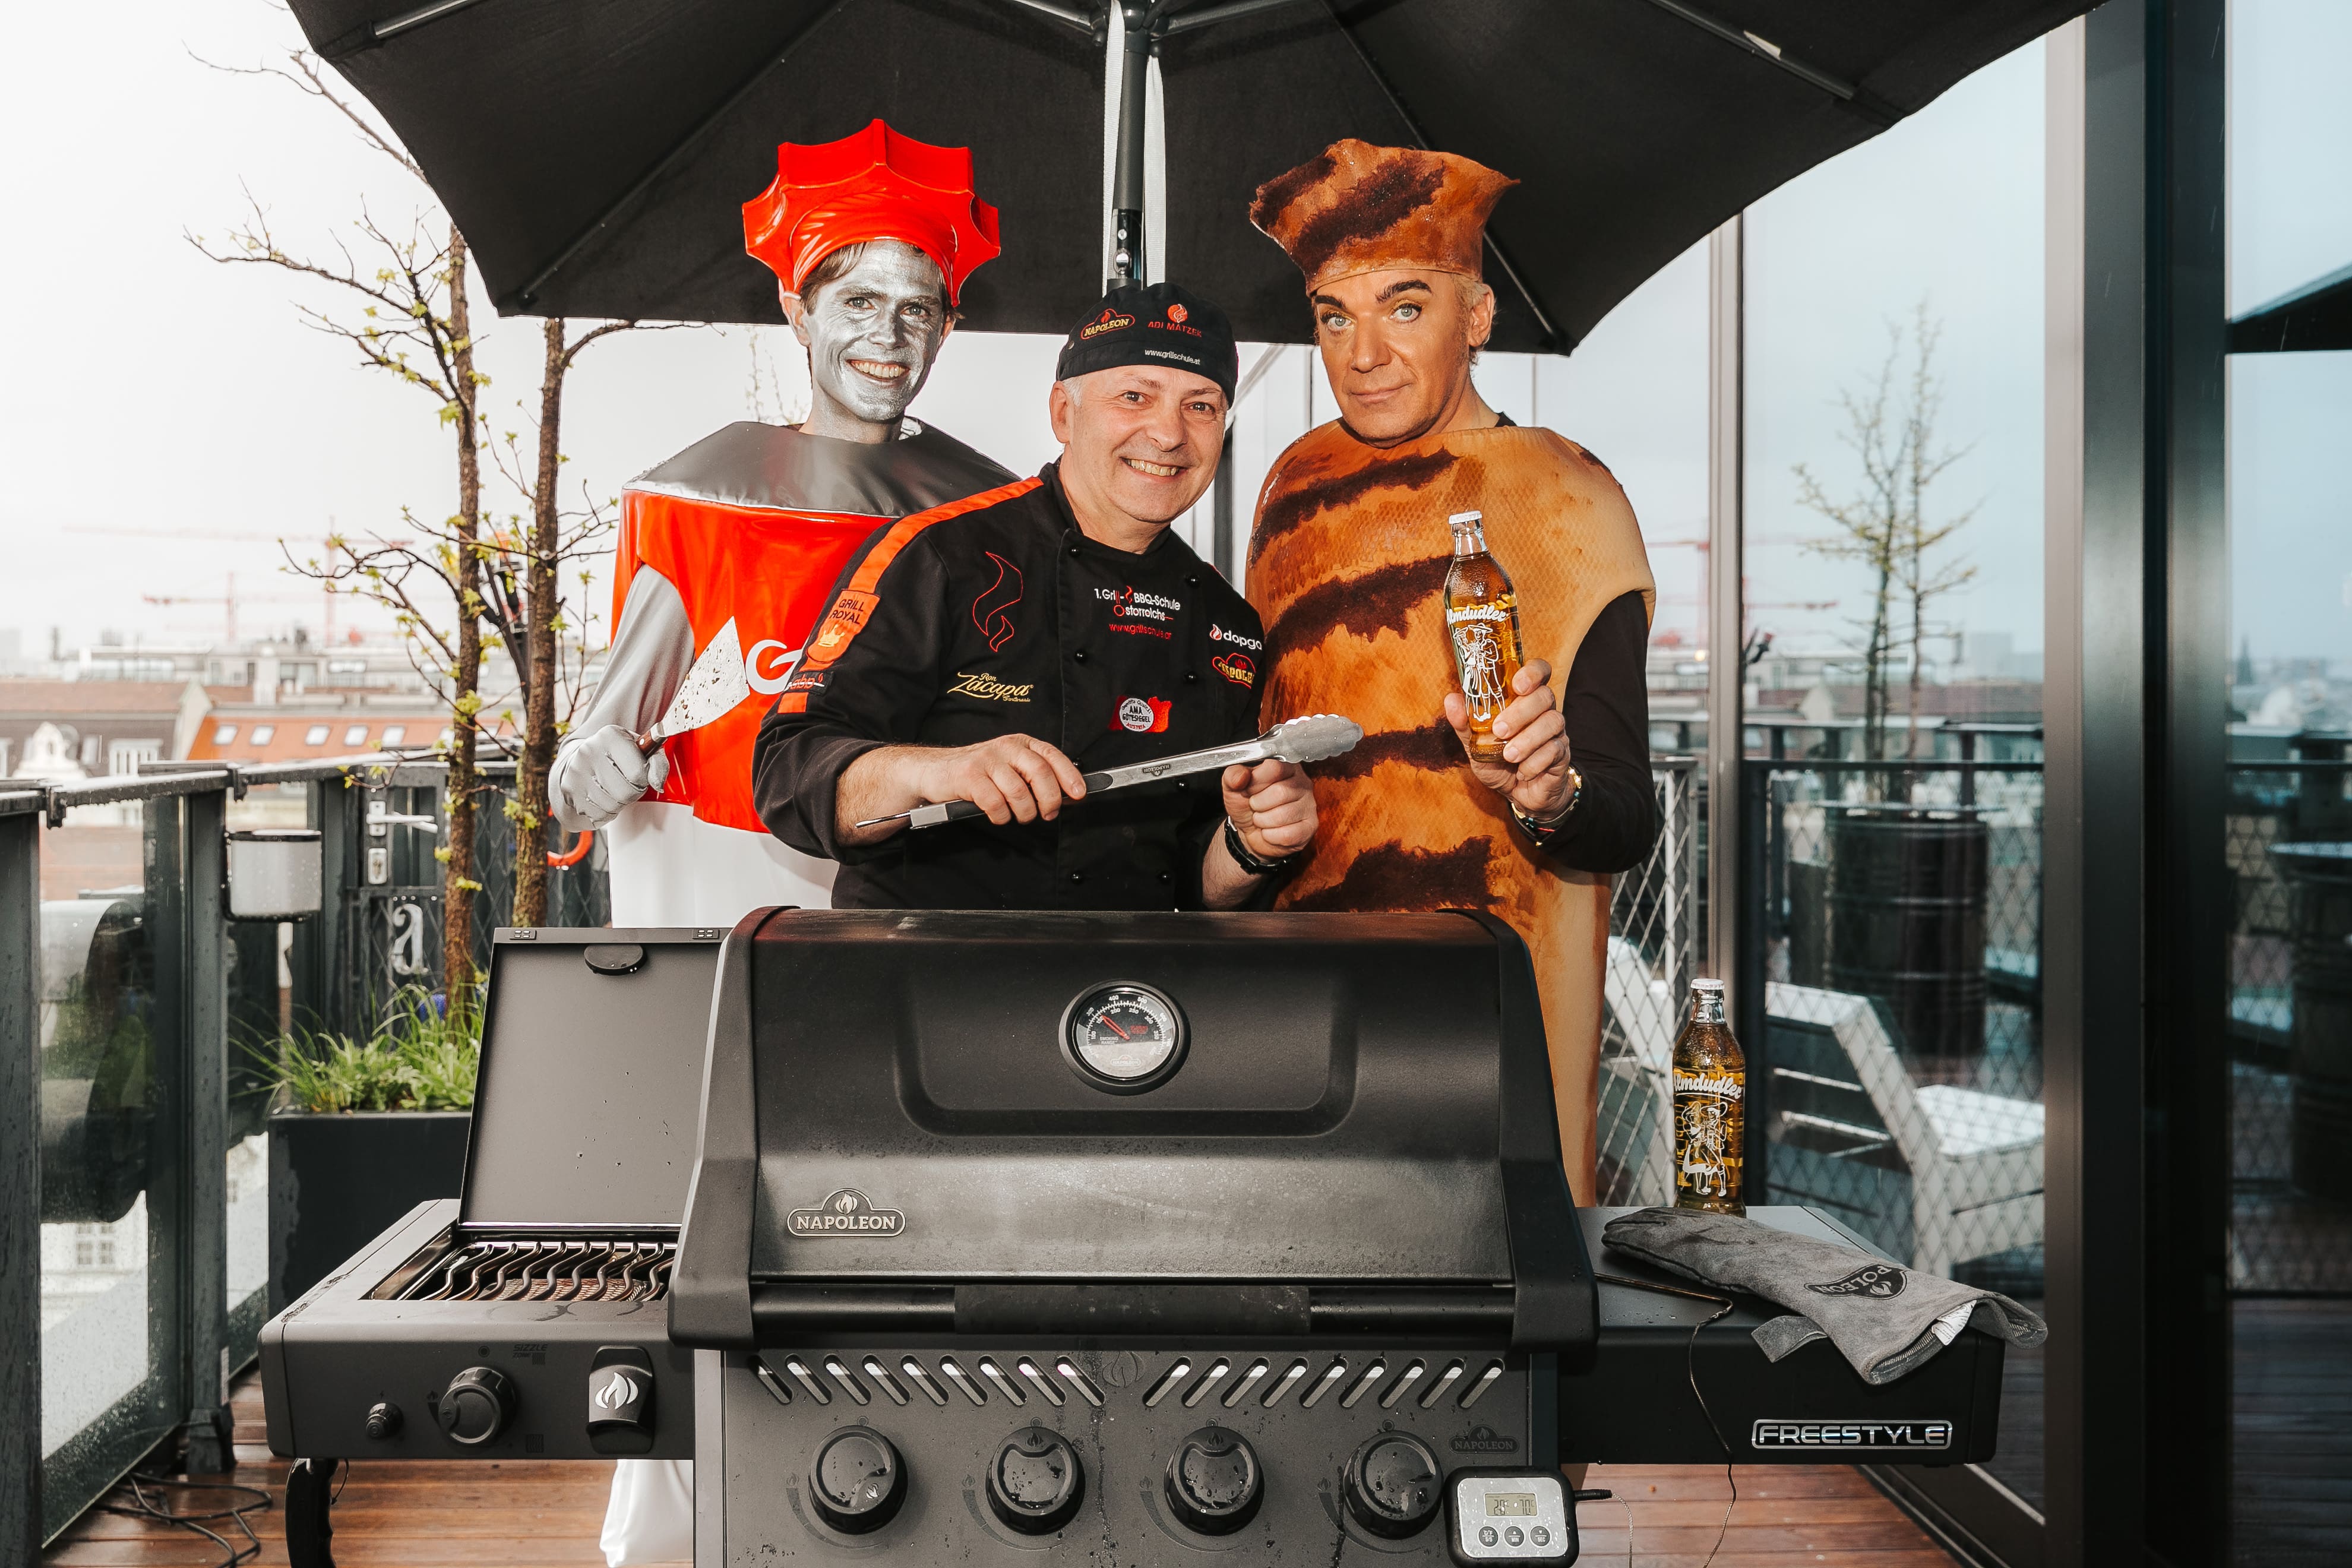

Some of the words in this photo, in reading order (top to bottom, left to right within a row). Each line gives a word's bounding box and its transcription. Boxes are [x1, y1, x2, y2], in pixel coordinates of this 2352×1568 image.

[1084, 318, 1130, 336] NAPOLEON
[1166, 323, 1202, 337] MATZEK
[1145, 349, 1200, 365] www.grillschule.at
[838, 599, 864, 612] GRILL
[1134, 592, 1181, 611] BBQ-Schule
[829, 610, 860, 624] ROYAL
[979, 672, 997, 681] Ron
[947, 672, 1030, 700] Zacapa
[1129, 705, 1143, 715] AMA
[796, 1216, 896, 1230] NAPOLEON
[1815, 1266, 1892, 1293] POLEON
[1759, 1425, 1945, 1443] FREESTYLE
[1455, 1440, 1513, 1450] NAPOLEON
